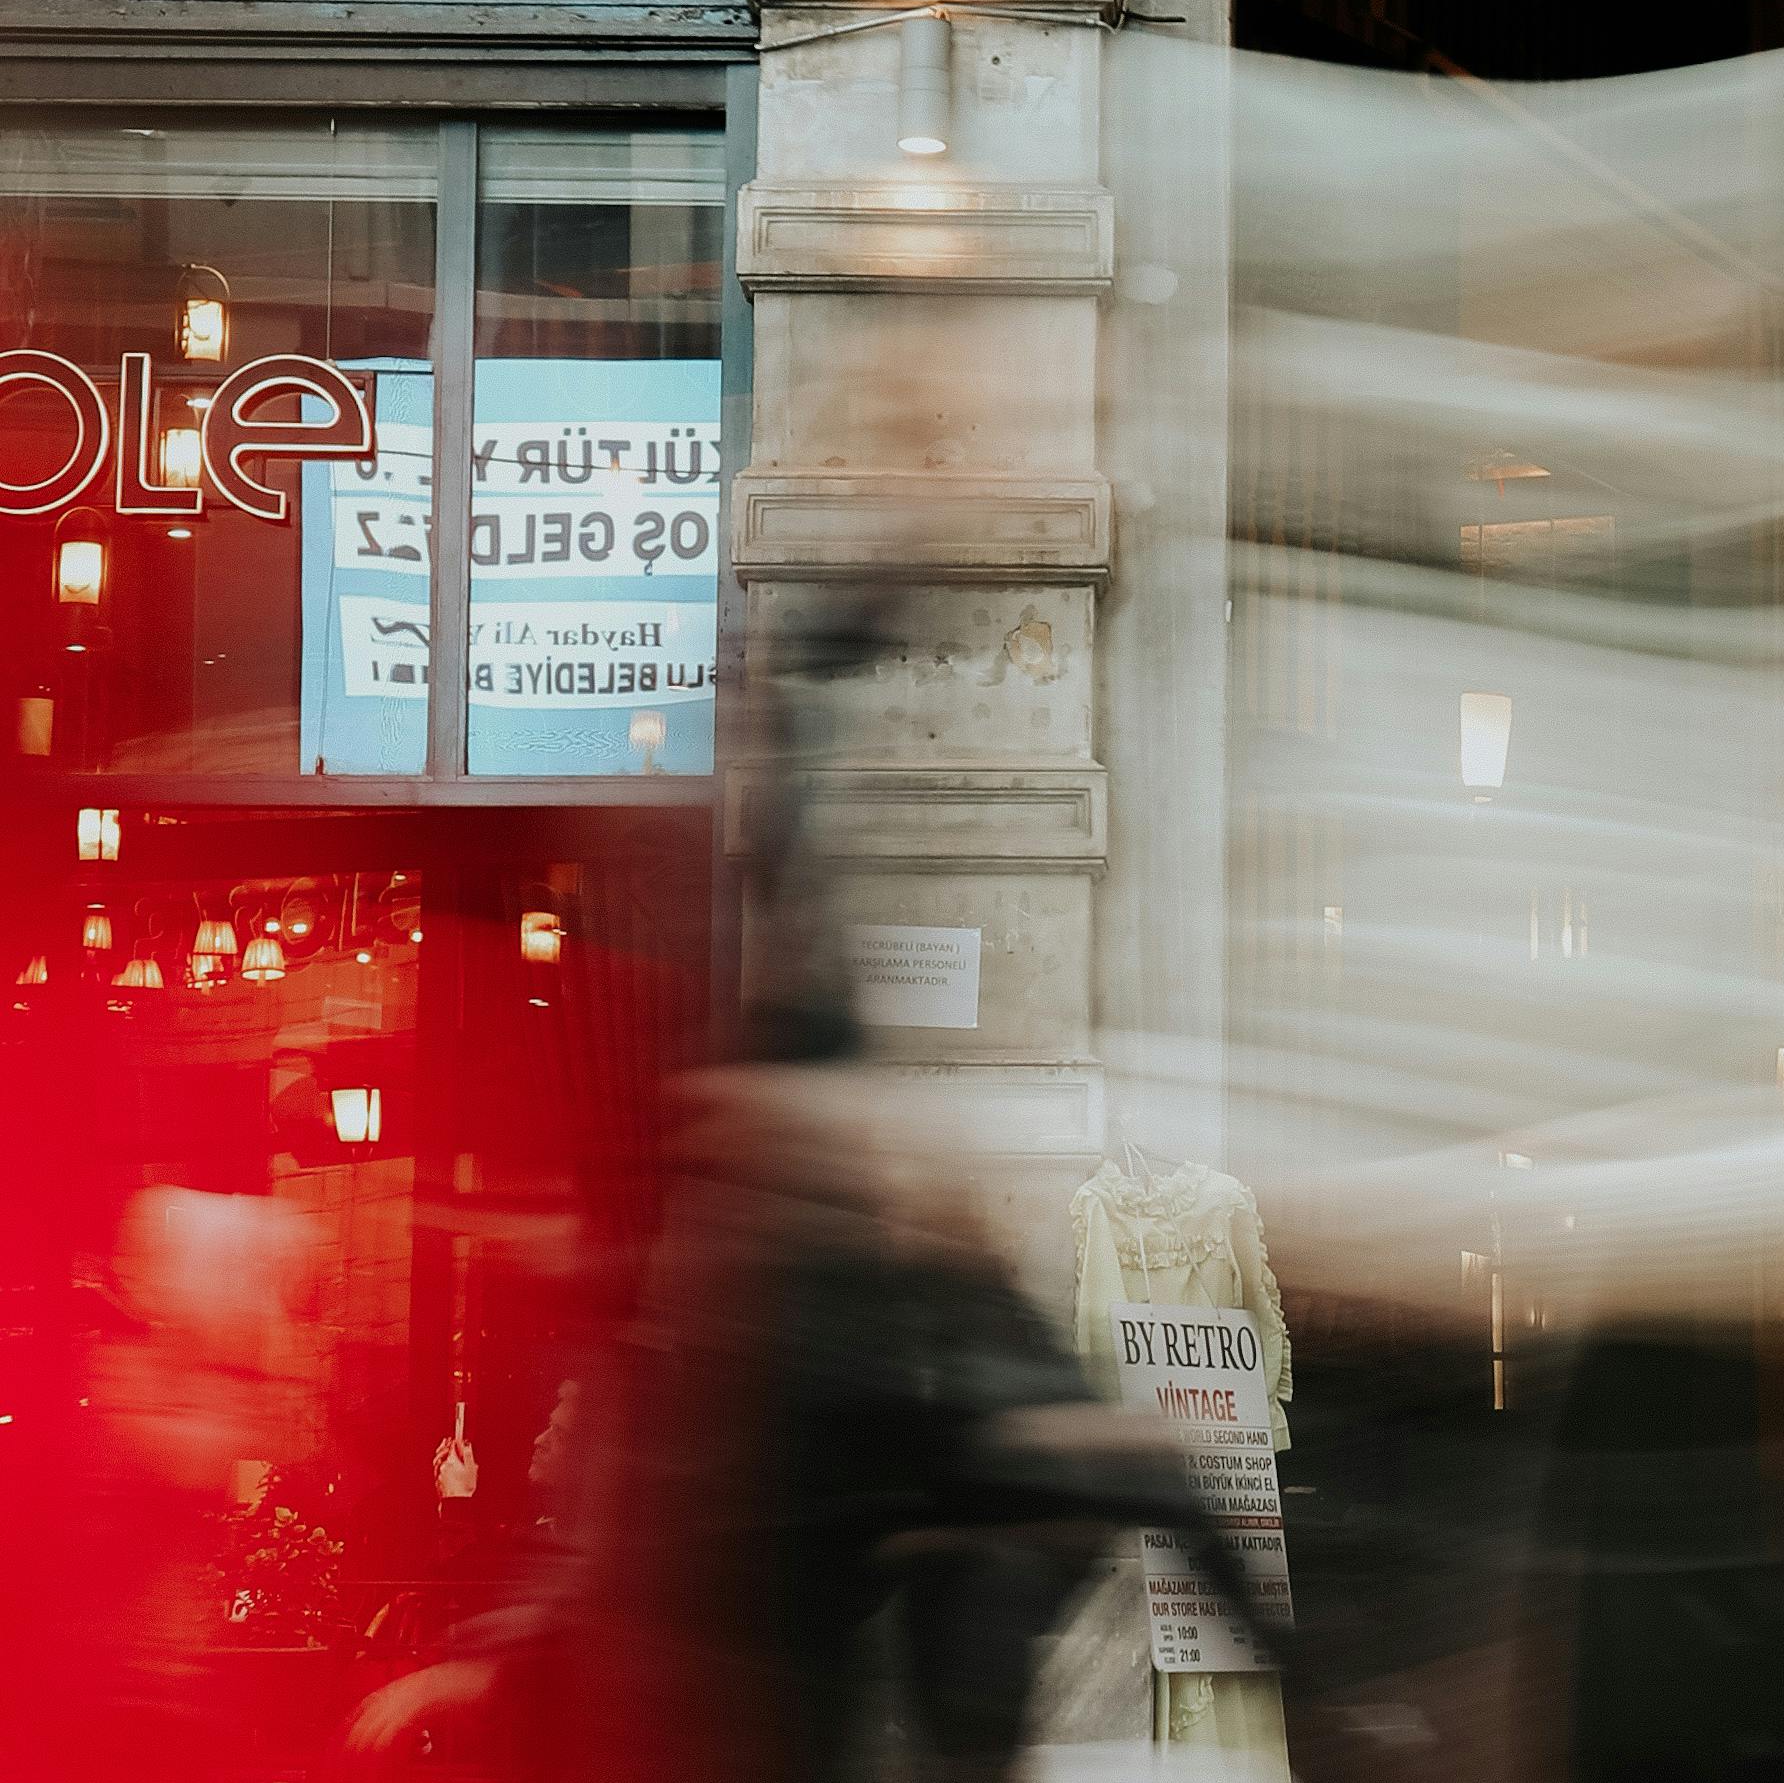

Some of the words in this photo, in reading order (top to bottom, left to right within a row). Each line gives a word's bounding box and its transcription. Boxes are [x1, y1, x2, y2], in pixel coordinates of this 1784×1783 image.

[1119, 1319, 1157, 1366] BY
[1161, 1322, 1258, 1372] RETRO
[1155, 1380, 1239, 1422] VİNTAGE
[1213, 1430, 1246, 1446] SECOND
[1246, 1431, 1269, 1446] HAND
[1199, 1455, 1243, 1470] COSTUM
[1244, 1456, 1273, 1471] SHOP
[1264, 1477, 1276, 1492] EL
[1229, 1494, 1279, 1513] MAĞAZASI
[1152, 1602, 1170, 1616] OUR
[1171, 1602, 1198, 1617] STORE
[1177, 1625, 1199, 1641] 10:00
[1179, 1647, 1201, 1664] 21:00
